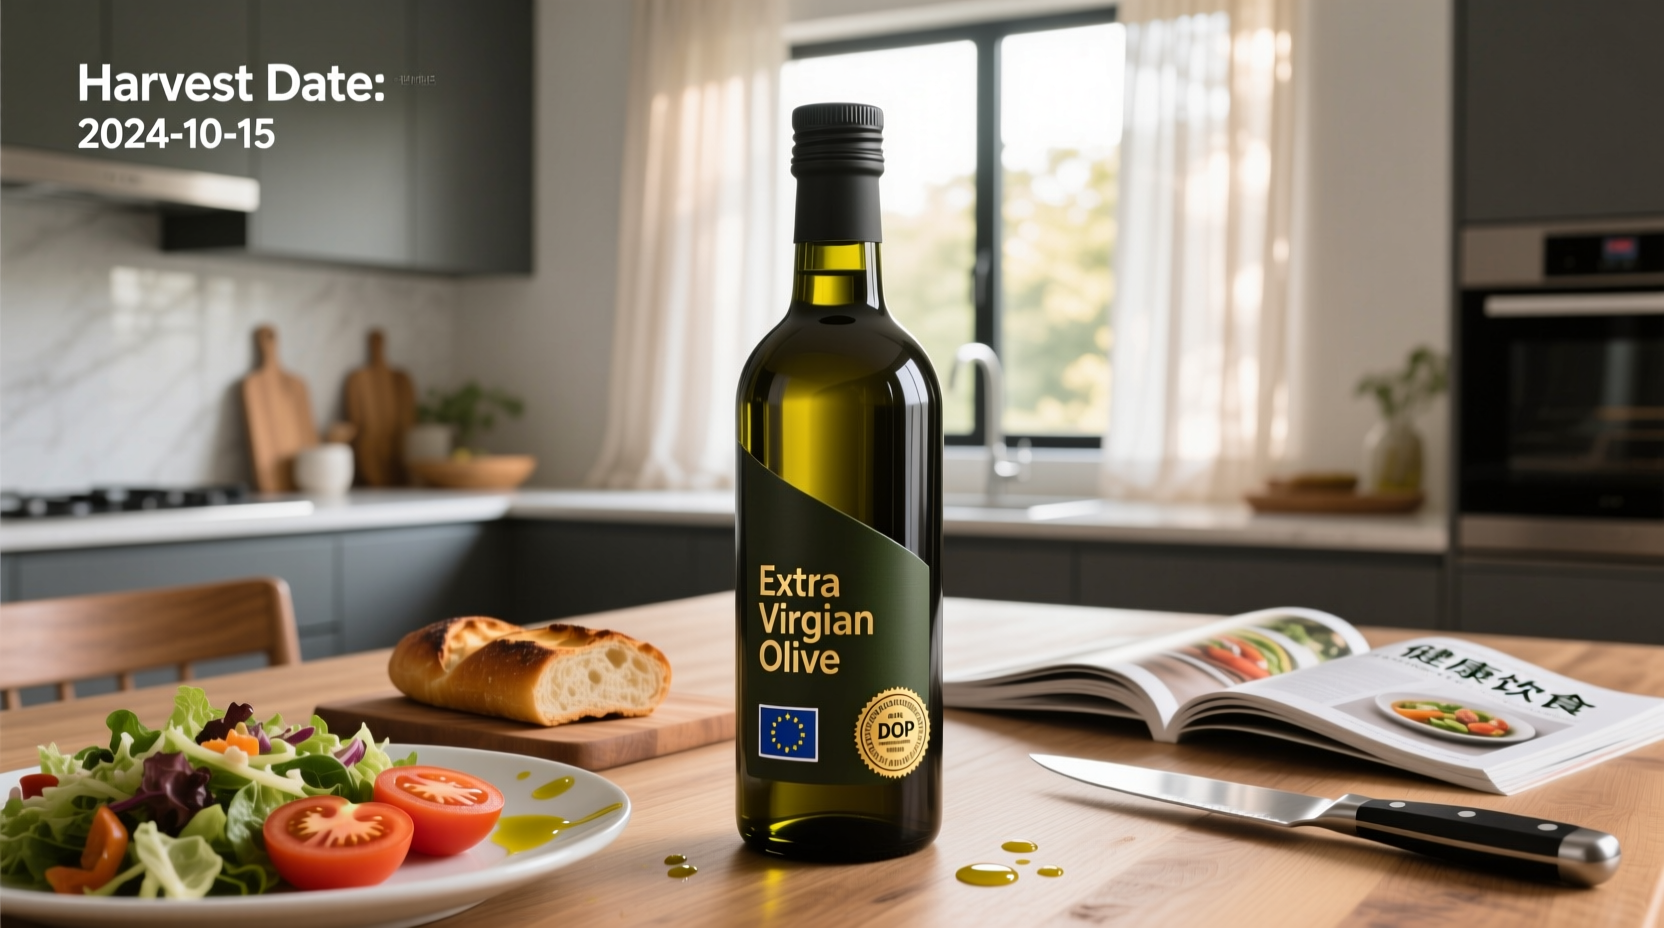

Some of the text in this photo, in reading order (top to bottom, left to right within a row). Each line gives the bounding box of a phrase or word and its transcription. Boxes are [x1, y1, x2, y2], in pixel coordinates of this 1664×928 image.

[759, 564, 840, 598] Extra
[758, 602, 874, 644] Virgian
[759, 639, 841, 675] Olive
[1400, 643, 1596, 717] 健康饮食
[877, 720, 915, 740] DOP
